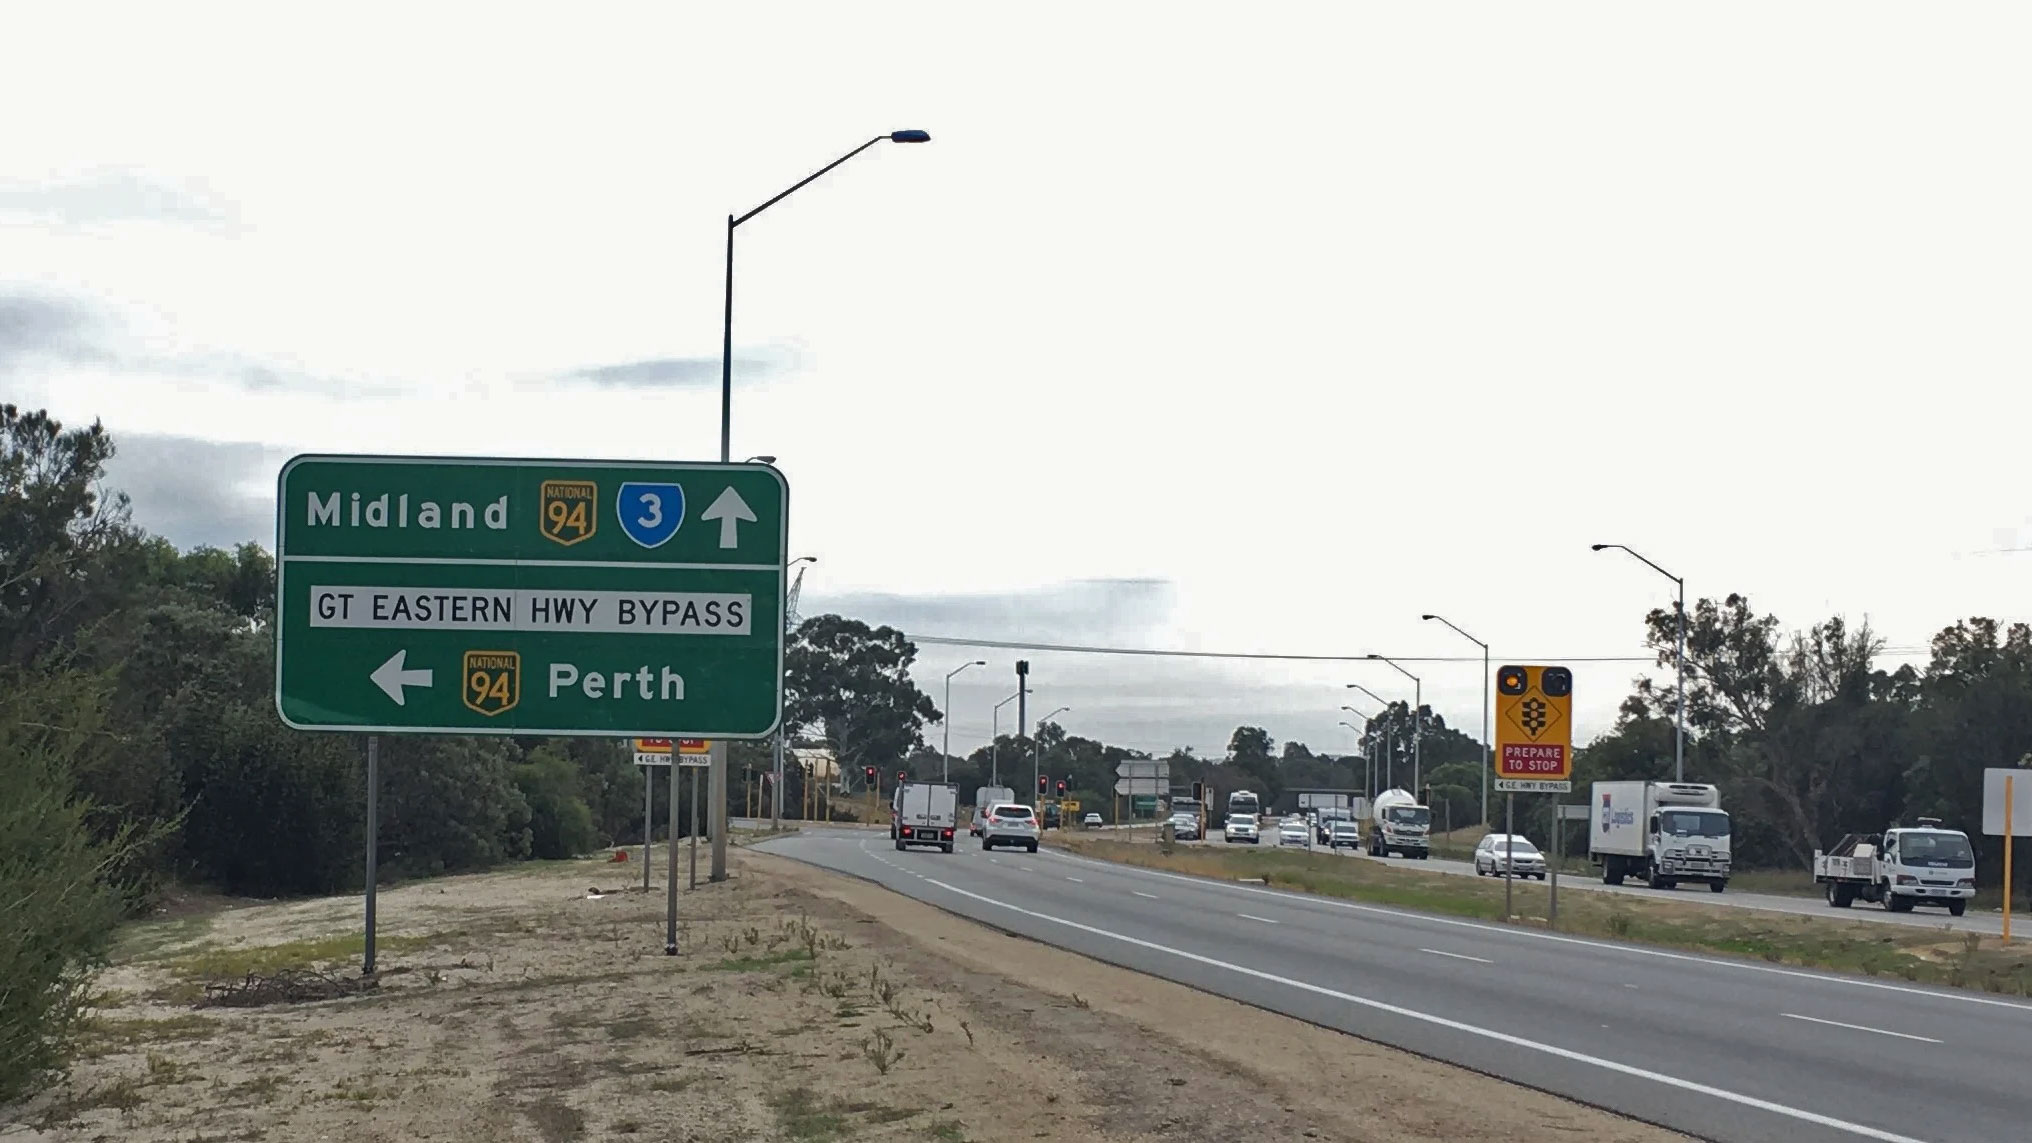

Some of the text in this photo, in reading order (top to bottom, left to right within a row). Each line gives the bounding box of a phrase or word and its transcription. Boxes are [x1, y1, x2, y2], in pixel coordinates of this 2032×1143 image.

[546, 485, 593, 500] NATIONAL
[307, 491, 508, 530] Midland
[548, 500, 588, 535] 94
[637, 493, 663, 528] 3
[318, 593, 745, 628] GT EASTERN HWY BYPASS
[469, 656, 515, 671] NATIONAL
[470, 671, 510, 705] 94
[549, 663, 685, 700] Perth
[1505, 747, 1561, 759] PREPARE
[1508, 759, 1558, 771] TO STOP
[1520, 781, 1537, 790] HWY
[1539, 782, 1568, 791] BYPASS
